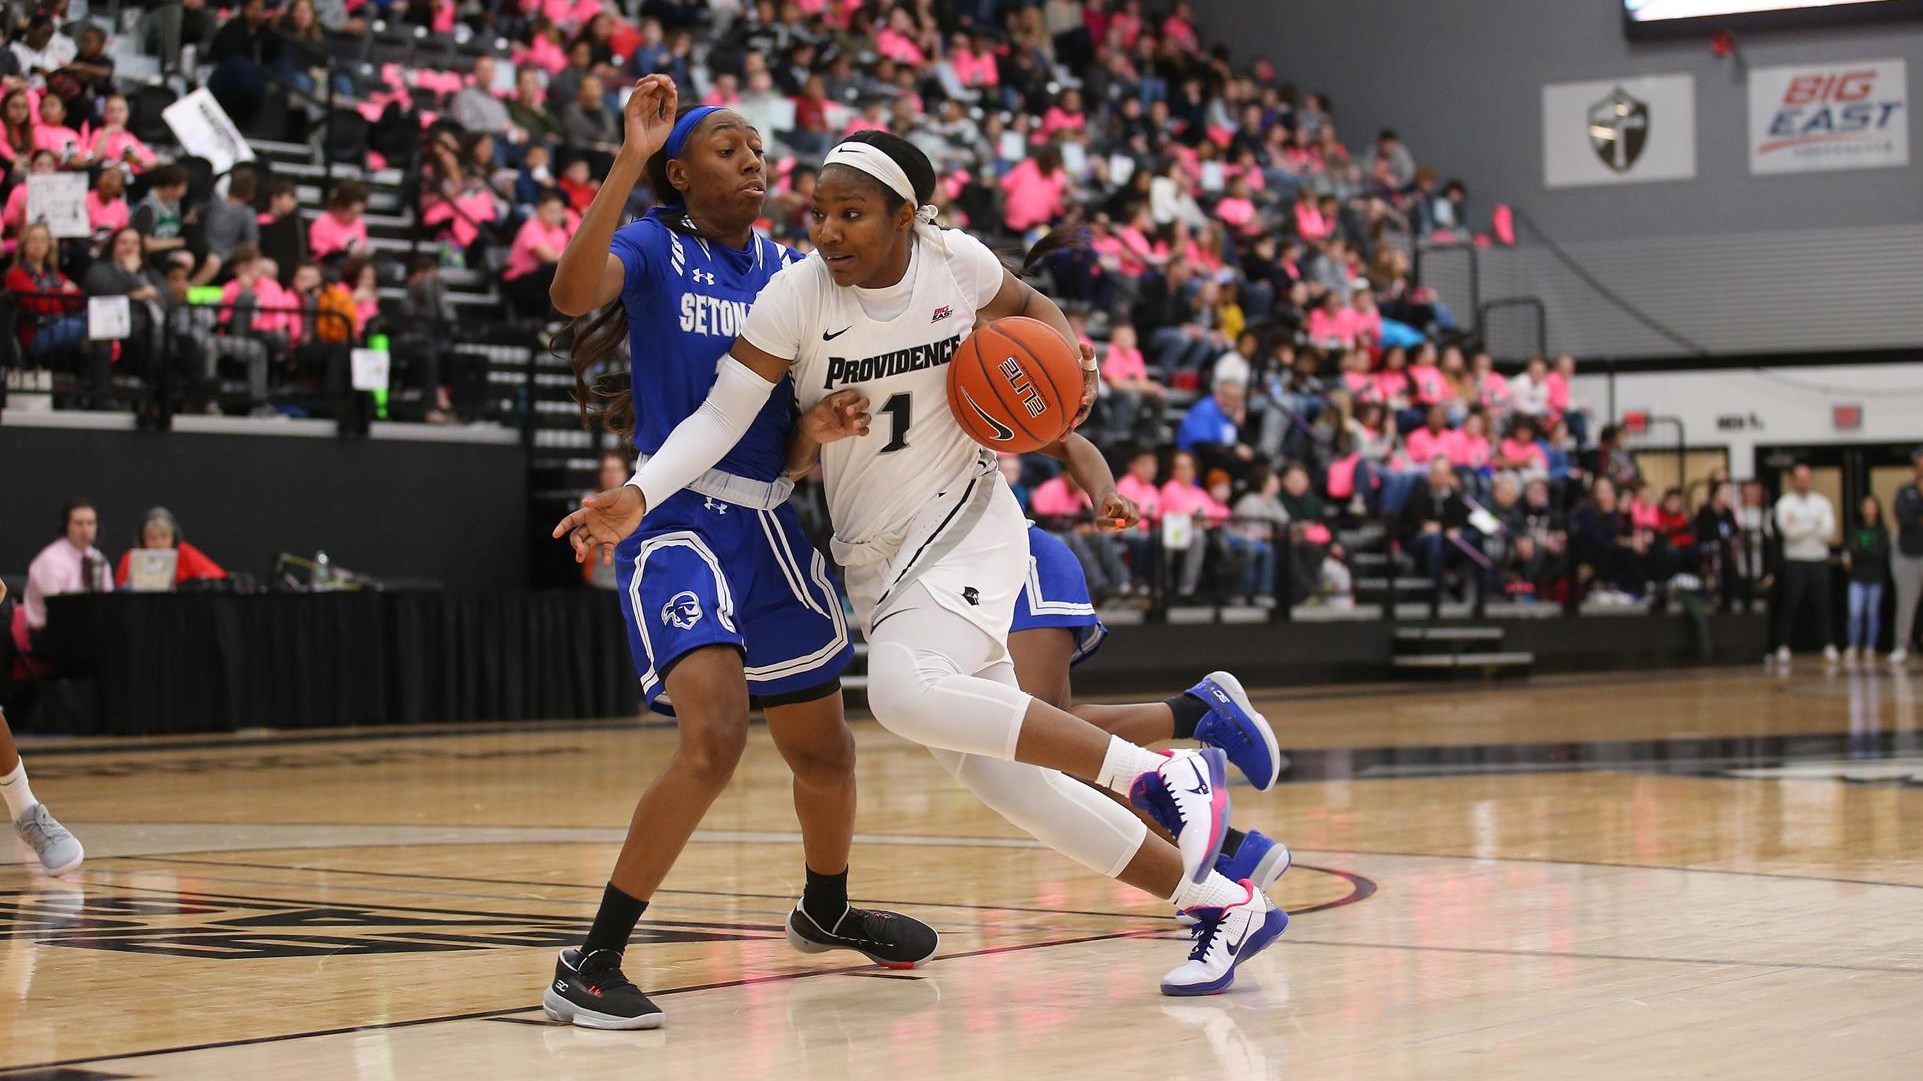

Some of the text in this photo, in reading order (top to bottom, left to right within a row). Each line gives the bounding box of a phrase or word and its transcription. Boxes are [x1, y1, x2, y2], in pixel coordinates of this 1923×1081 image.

[1782, 70, 1877, 106] BIG
[1769, 101, 1903, 136] EAST
[679, 292, 751, 338] SETON
[998, 356, 1047, 418] ELITE
[876, 391, 913, 456] 1
